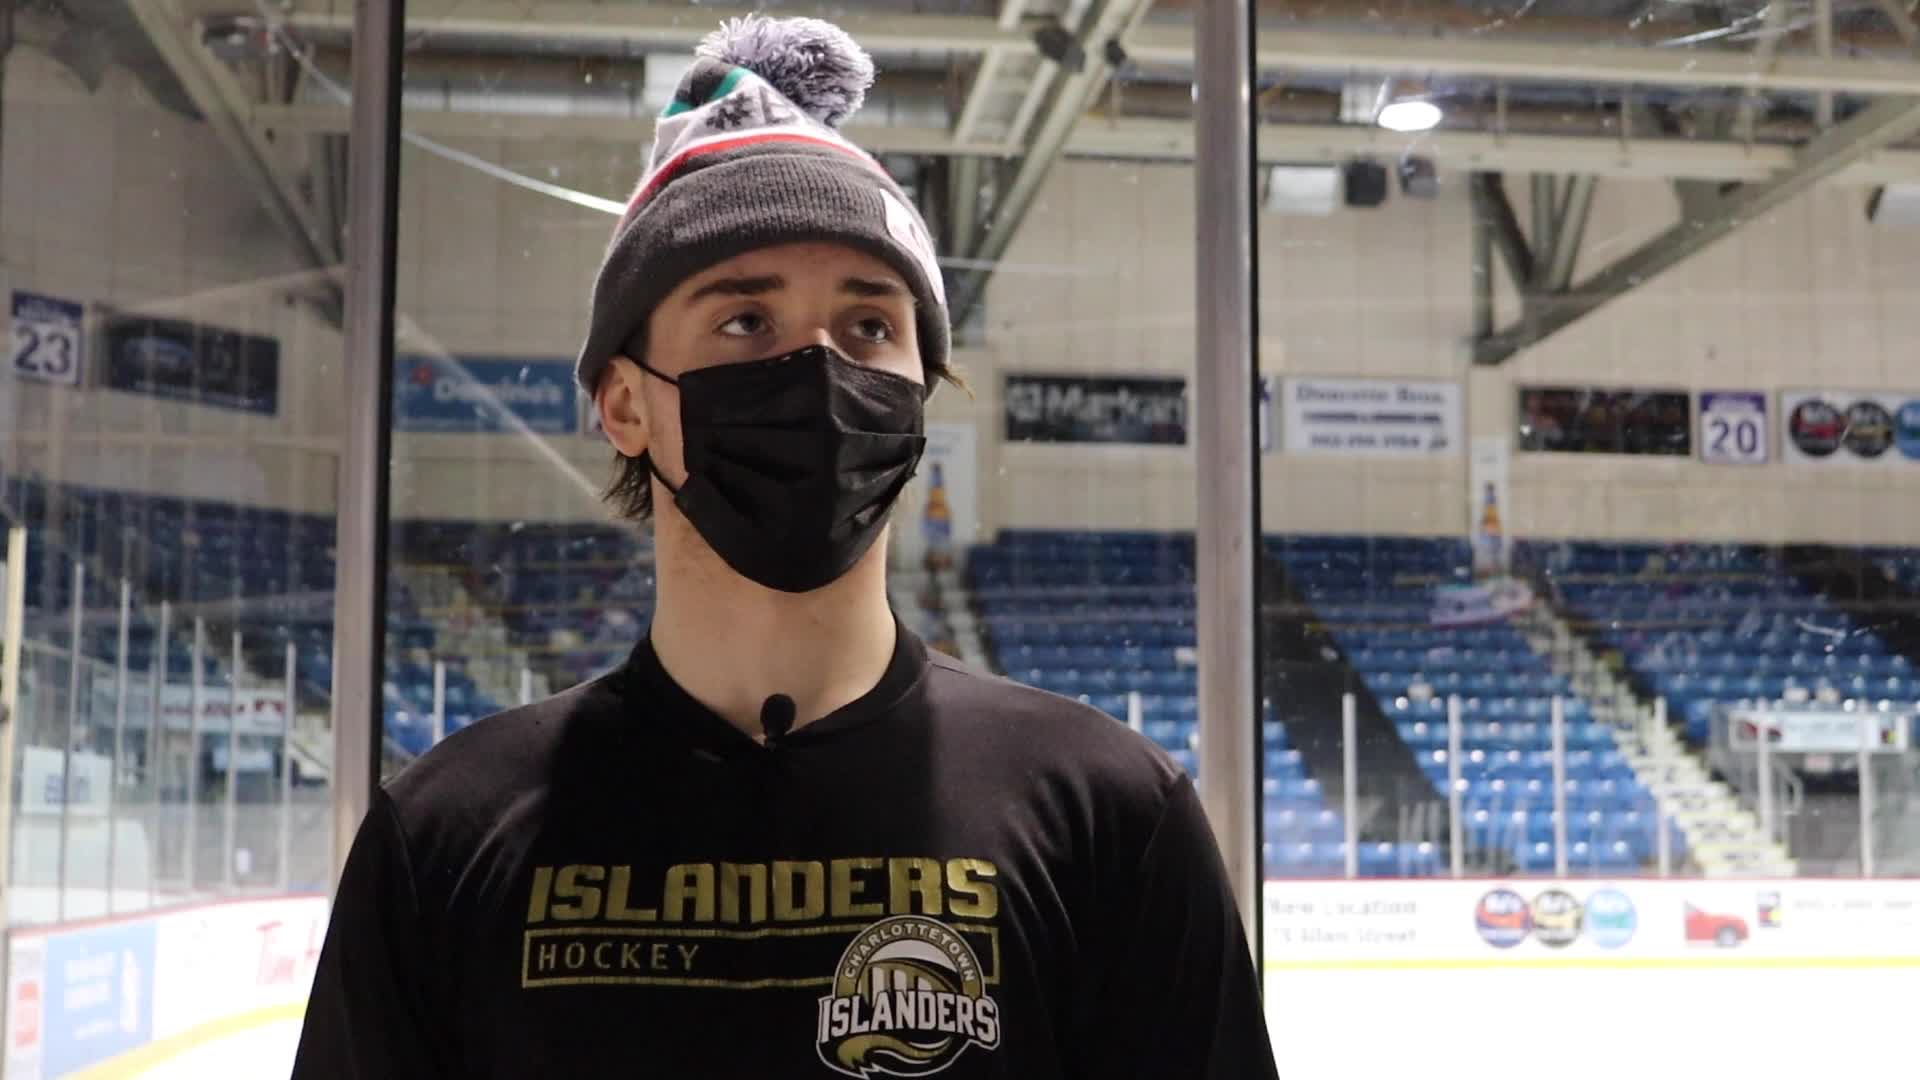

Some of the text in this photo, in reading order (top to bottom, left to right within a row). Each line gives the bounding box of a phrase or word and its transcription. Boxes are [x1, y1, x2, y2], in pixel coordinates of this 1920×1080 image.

[15, 326, 71, 375] 23
[1711, 418, 1757, 454] 20
[527, 857, 999, 923] ISLANDERS
[538, 942, 699, 971] HOCKEY
[844, 923, 976, 982] CHARLOTTETOWN
[818, 989, 996, 1045] ISLANDERS
